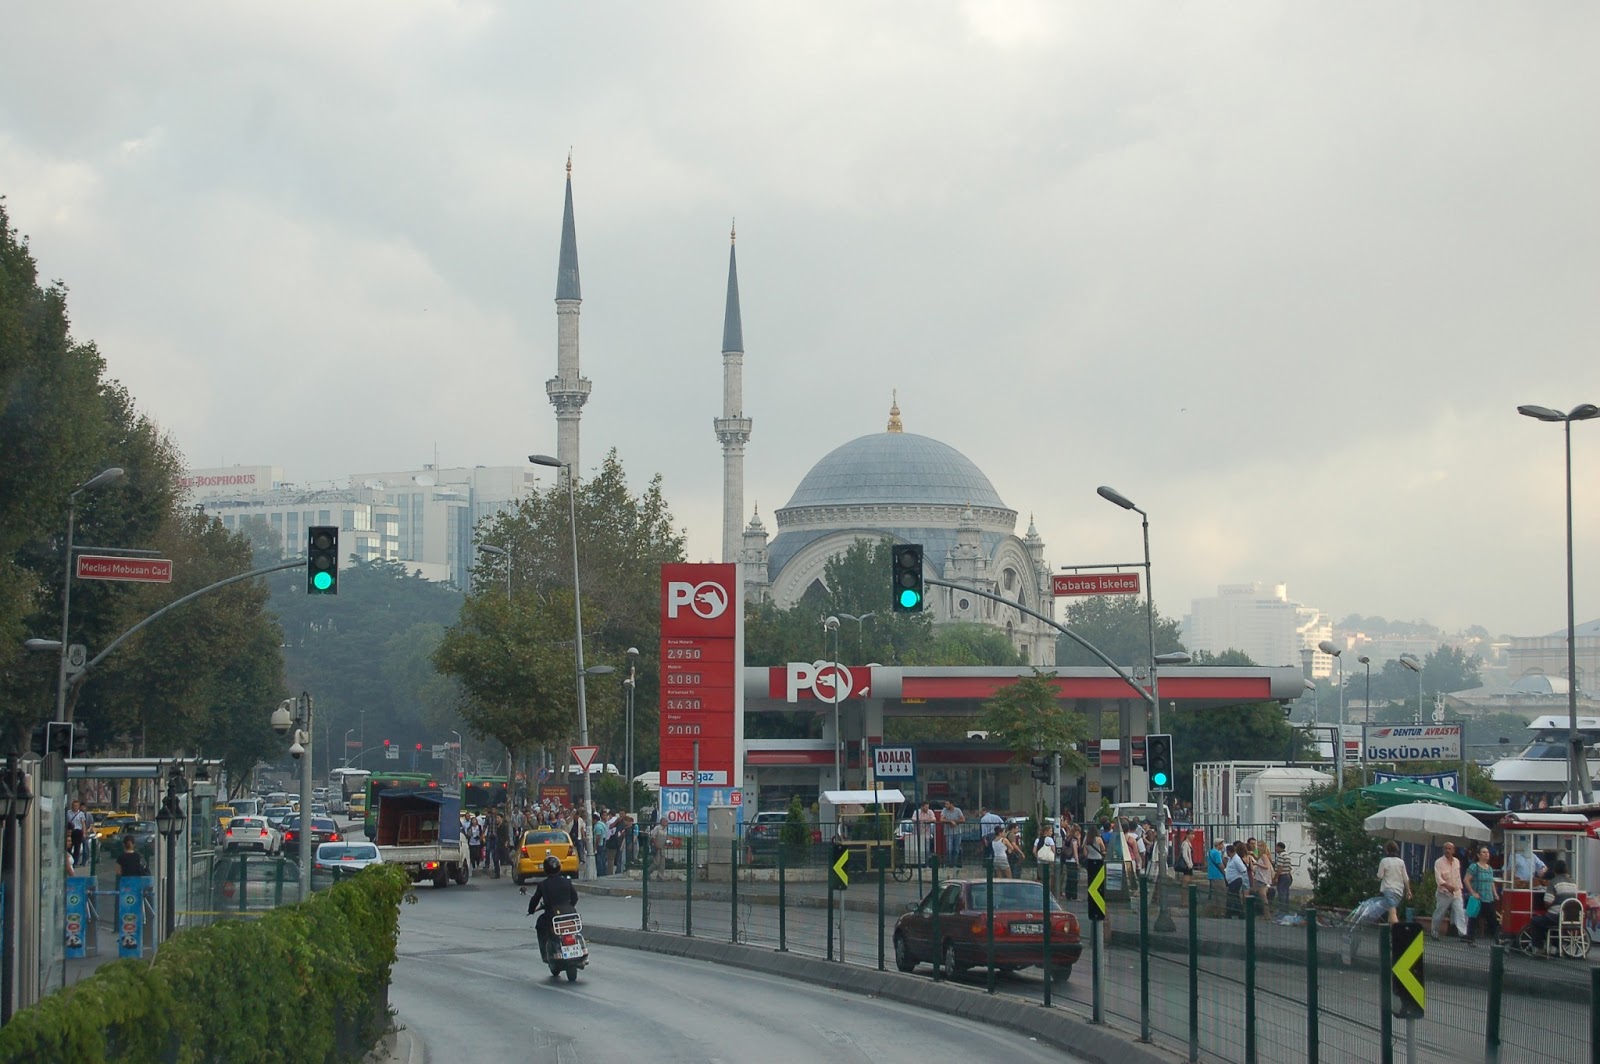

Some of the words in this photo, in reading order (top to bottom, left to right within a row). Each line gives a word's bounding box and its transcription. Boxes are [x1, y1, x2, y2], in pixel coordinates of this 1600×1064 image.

[197, 474, 256, 487] BOSPHORUS
[81, 562, 111, 572] Meclis-i
[112, 564, 150, 575] Mebusan
[151, 566, 169, 576] Cad.
[1055, 580, 1097, 591] Kabataş
[1099, 577, 1137, 589] İskelesi
[1393, 728, 1422, 737] DENTUR
[1424, 727, 1459, 736] AVRASYA
[878, 751, 911, 763] ADALAR
[666, 791, 690, 805] 100
